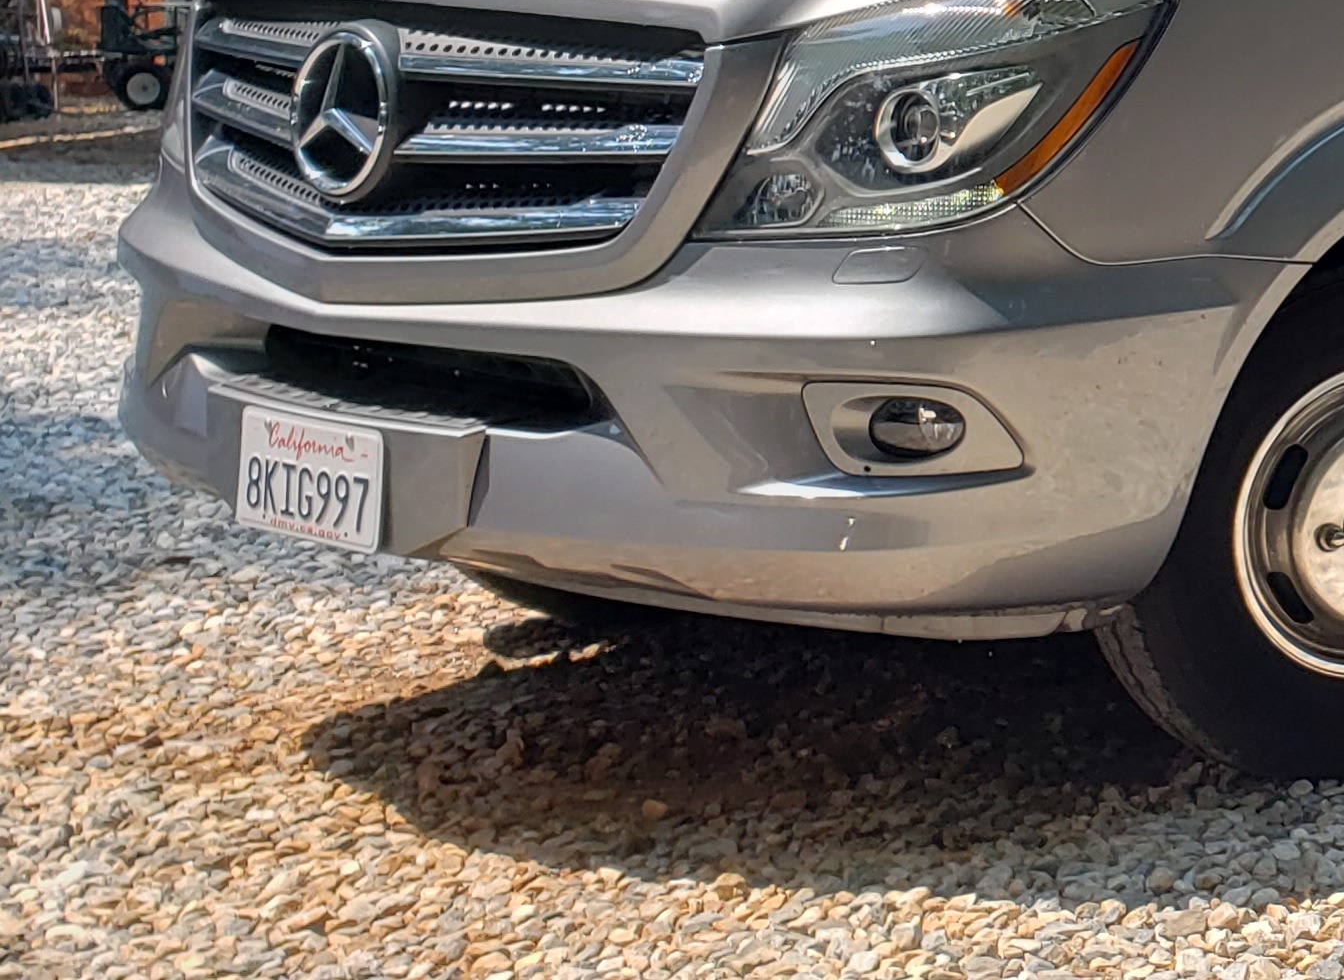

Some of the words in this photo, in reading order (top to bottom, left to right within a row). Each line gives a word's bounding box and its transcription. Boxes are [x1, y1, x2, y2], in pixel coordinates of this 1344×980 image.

[268, 421, 355, 462] California
[246, 455, 370, 534] 8KIG997
[270, 517, 342, 541] dmv.ca.gov
